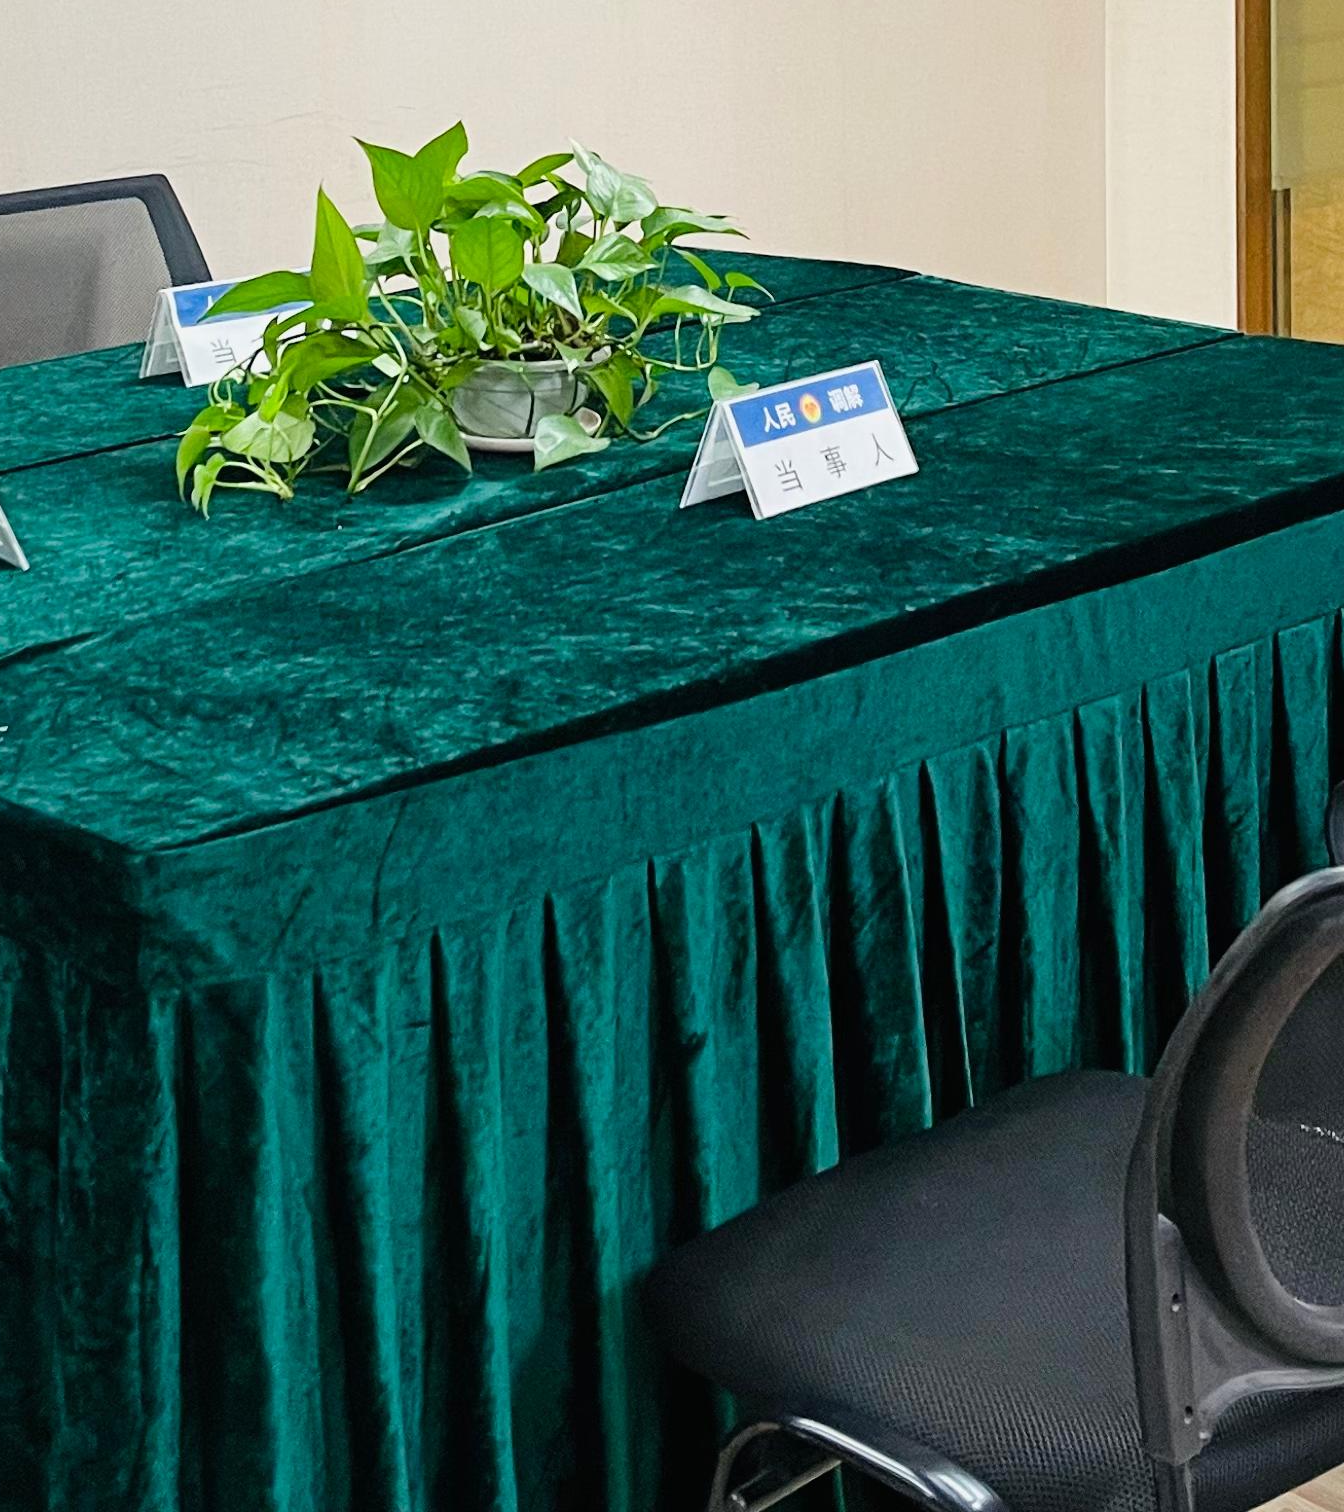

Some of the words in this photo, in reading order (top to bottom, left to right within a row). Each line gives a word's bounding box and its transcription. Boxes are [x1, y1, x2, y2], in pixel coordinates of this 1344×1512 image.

[764, 402, 797, 433] 人民
[775, 433, 894, 492] 当事人
